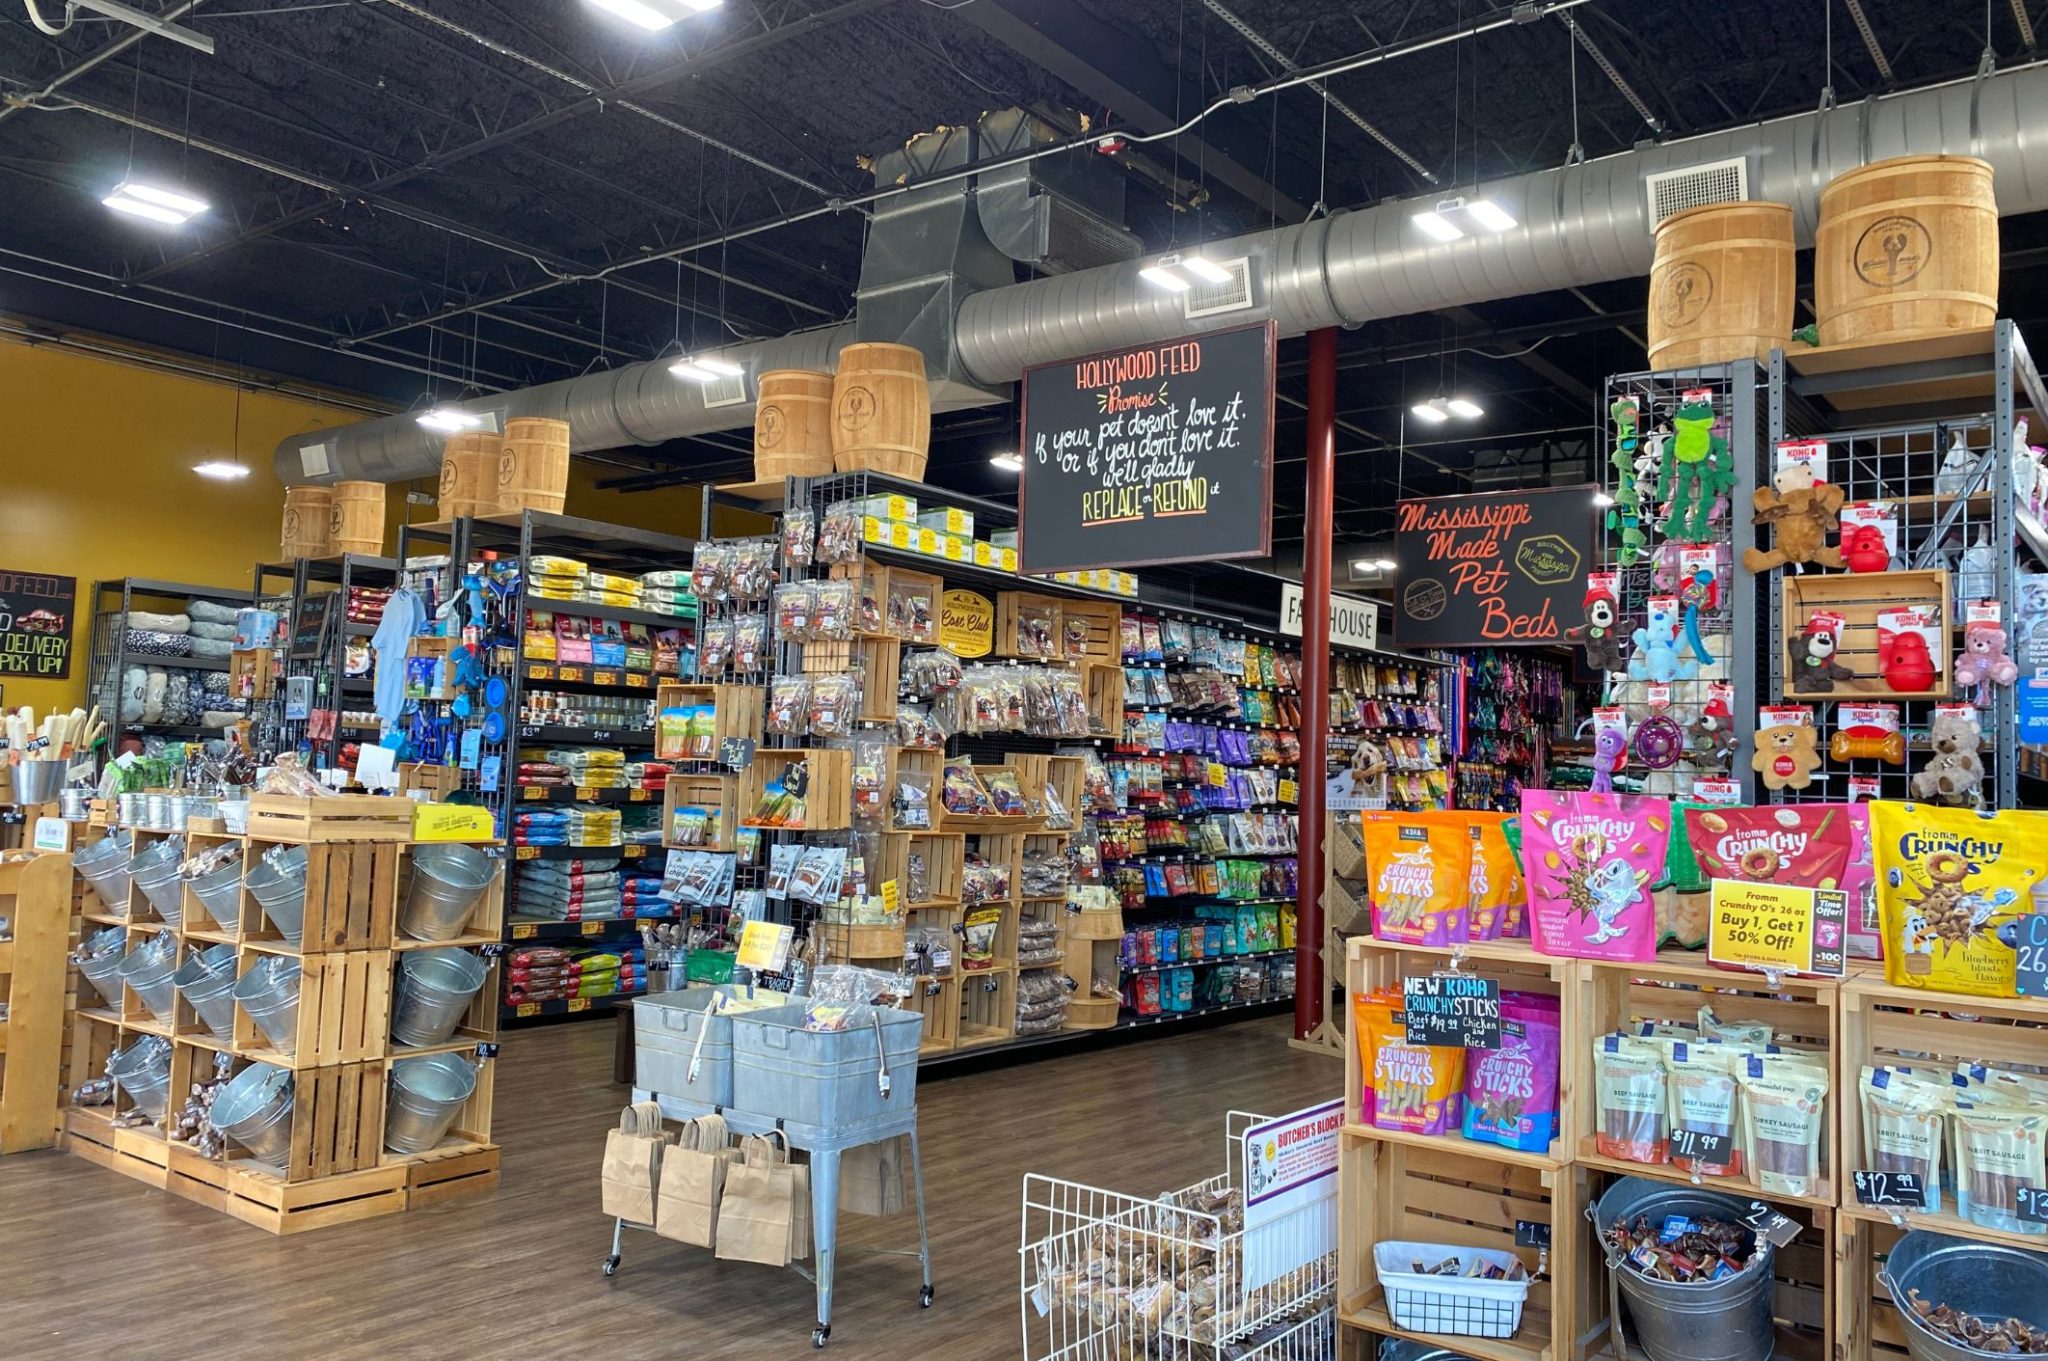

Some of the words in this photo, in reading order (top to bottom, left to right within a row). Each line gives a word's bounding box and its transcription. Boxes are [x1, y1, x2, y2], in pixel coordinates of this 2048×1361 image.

[1077, 350, 1156, 390] HOLLYWOOD
[1160, 342, 1201, 376] FEED
[1107, 385, 1158, 414] Promise
[1053, 426, 1093, 462] your
[1098, 413, 1125, 450] pet
[1127, 402, 1180, 436] doesn't
[1187, 397, 1217, 427] love
[1062, 452, 1081, 473] or
[1086, 443, 1099, 476] if
[1105, 438, 1136, 469] you
[1138, 429, 1177, 462] don't
[1180, 427, 1213, 454] love
[1787, 449, 1810, 457] KONG
[1103, 459, 1139, 488] we'll
[1141, 453, 1196, 490] gladly
[1083, 485, 1144, 520] REPLACE
[1153, 476, 1207, 513] REFUND
[1210, 481, 1221, 496] it
[1400, 503, 1533, 541] Mississippi
[1856, 509, 1876, 518] KONG
[1426, 529, 1501, 561] Made
[1448, 560, 1511, 596] Pet
[941, 608, 966, 628] Cost
[967, 613, 990, 633] Club
[1288, 596, 1373, 640] FAHOUSE
[1478, 596, 1560, 640] Beds
[1896, 613, 1918, 624] KONG
[5, 633, 69, 657] DELIVERY
[0, 653, 29, 673] PICK
[37, 656, 63, 673] UP!
[1773, 712, 1794, 721] KONG
[1852, 710, 1875, 719] KONG
[1703, 784, 1726, 794] KONG
[1736, 827, 1768, 841] fromm
[1922, 827, 1959, 841] fromm
[1386, 863, 1435, 879] CRUNCHY
[1377, 875, 1435, 898] STICKS
[1746, 891, 1779, 903] Fromm
[1820, 900, 1842, 909] Time
[1719, 899, 1759, 913] Crunchy
[1760, 902, 1776, 913] O's
[1780, 906, 1793, 915] 26
[1795, 908, 1806, 917] oz
[1815, 907, 1844, 917] Offer!
[1721, 912, 1751, 930] Buy
[1753, 915, 1763, 931] 1,
[1767, 918, 1794, 932] Get
[1797, 920, 1804, 933] 1
[1727, 929, 1760, 945] 50%
[1763, 933, 1795, 951] Off!
[1961, 951, 2011, 968] blueberry
[1970, 964, 2002, 975] blasts
[1404, 976, 1441, 996] NEW
[1445, 979, 1488, 997] KOHA
[1408, 1012, 1430, 1024] Beef
[1462, 1016, 1497, 1031] Chicken
[1408, 1029, 1427, 1041] Rice
[1464, 1033, 1487, 1049] Rice
[1378, 1047, 1432, 1067] CRUNCHY
[1374, 1060, 1436, 1087] STICKS
[1480, 1057, 1534, 1078] CRUNCHY
[1473, 1069, 1535, 1098] STICKS
[1613, 1089, 1629, 1097] BEEF
[1629, 1091, 1657, 1100] SAUSAGE
[1699, 1101, 1729, 1110] SAUSAGE
[1278, 1121, 1317, 1149] BUTCHER'S
[1317, 1113, 1339, 1135] BLOCK
[1753, 1116, 1778, 1126] TURKEY
[1672, 1130, 1719, 1155] $11.99
[1896, 1131, 1930, 1144] SAUSAGE
[1855, 1171, 1914, 1204] $12.99
[1749, 1201, 1790, 1231] $2.49
